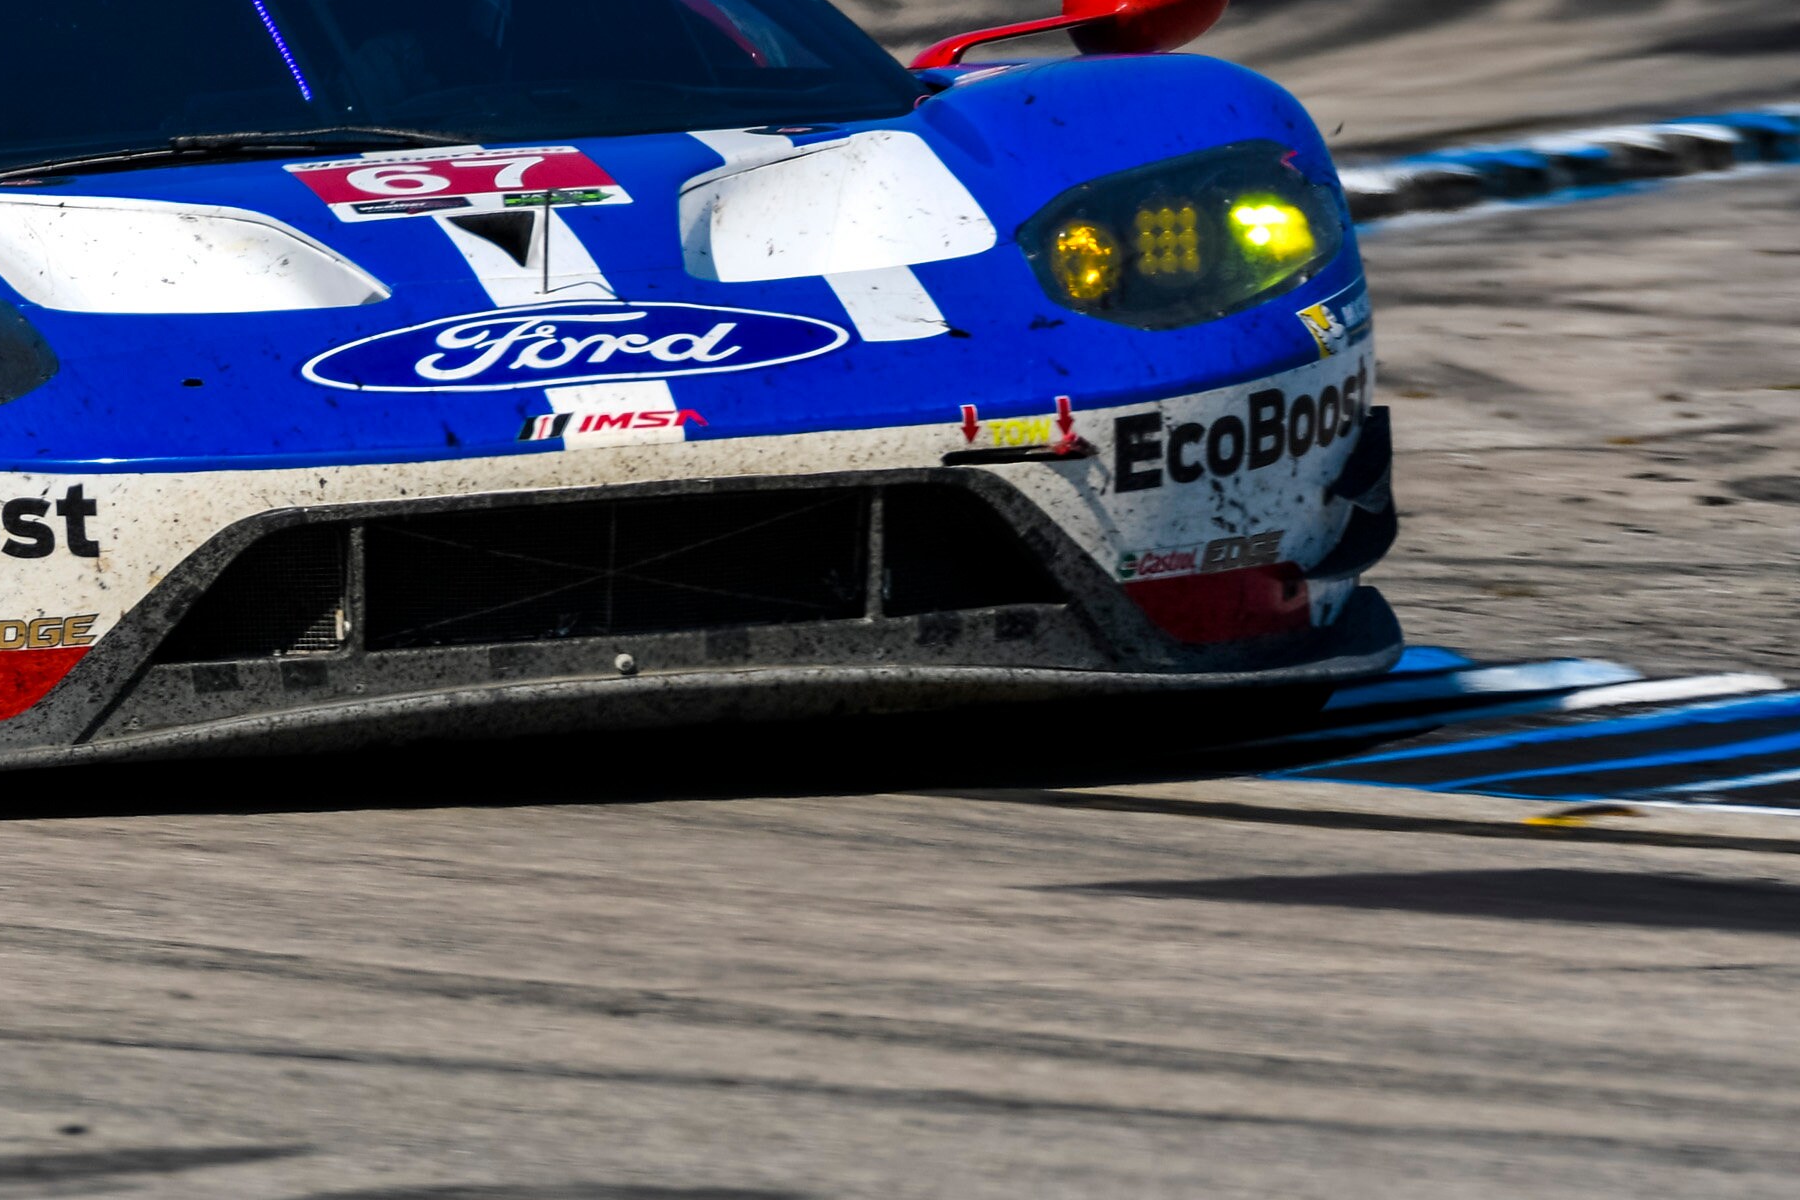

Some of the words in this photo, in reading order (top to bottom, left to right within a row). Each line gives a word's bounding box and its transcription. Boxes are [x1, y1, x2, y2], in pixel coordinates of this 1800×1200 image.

[346, 156, 545, 195] 67
[414, 311, 741, 380] Ford
[578, 409, 709, 433] IMSA
[987, 418, 1051, 446] TOW
[1114, 357, 1368, 494] EcoBoost
